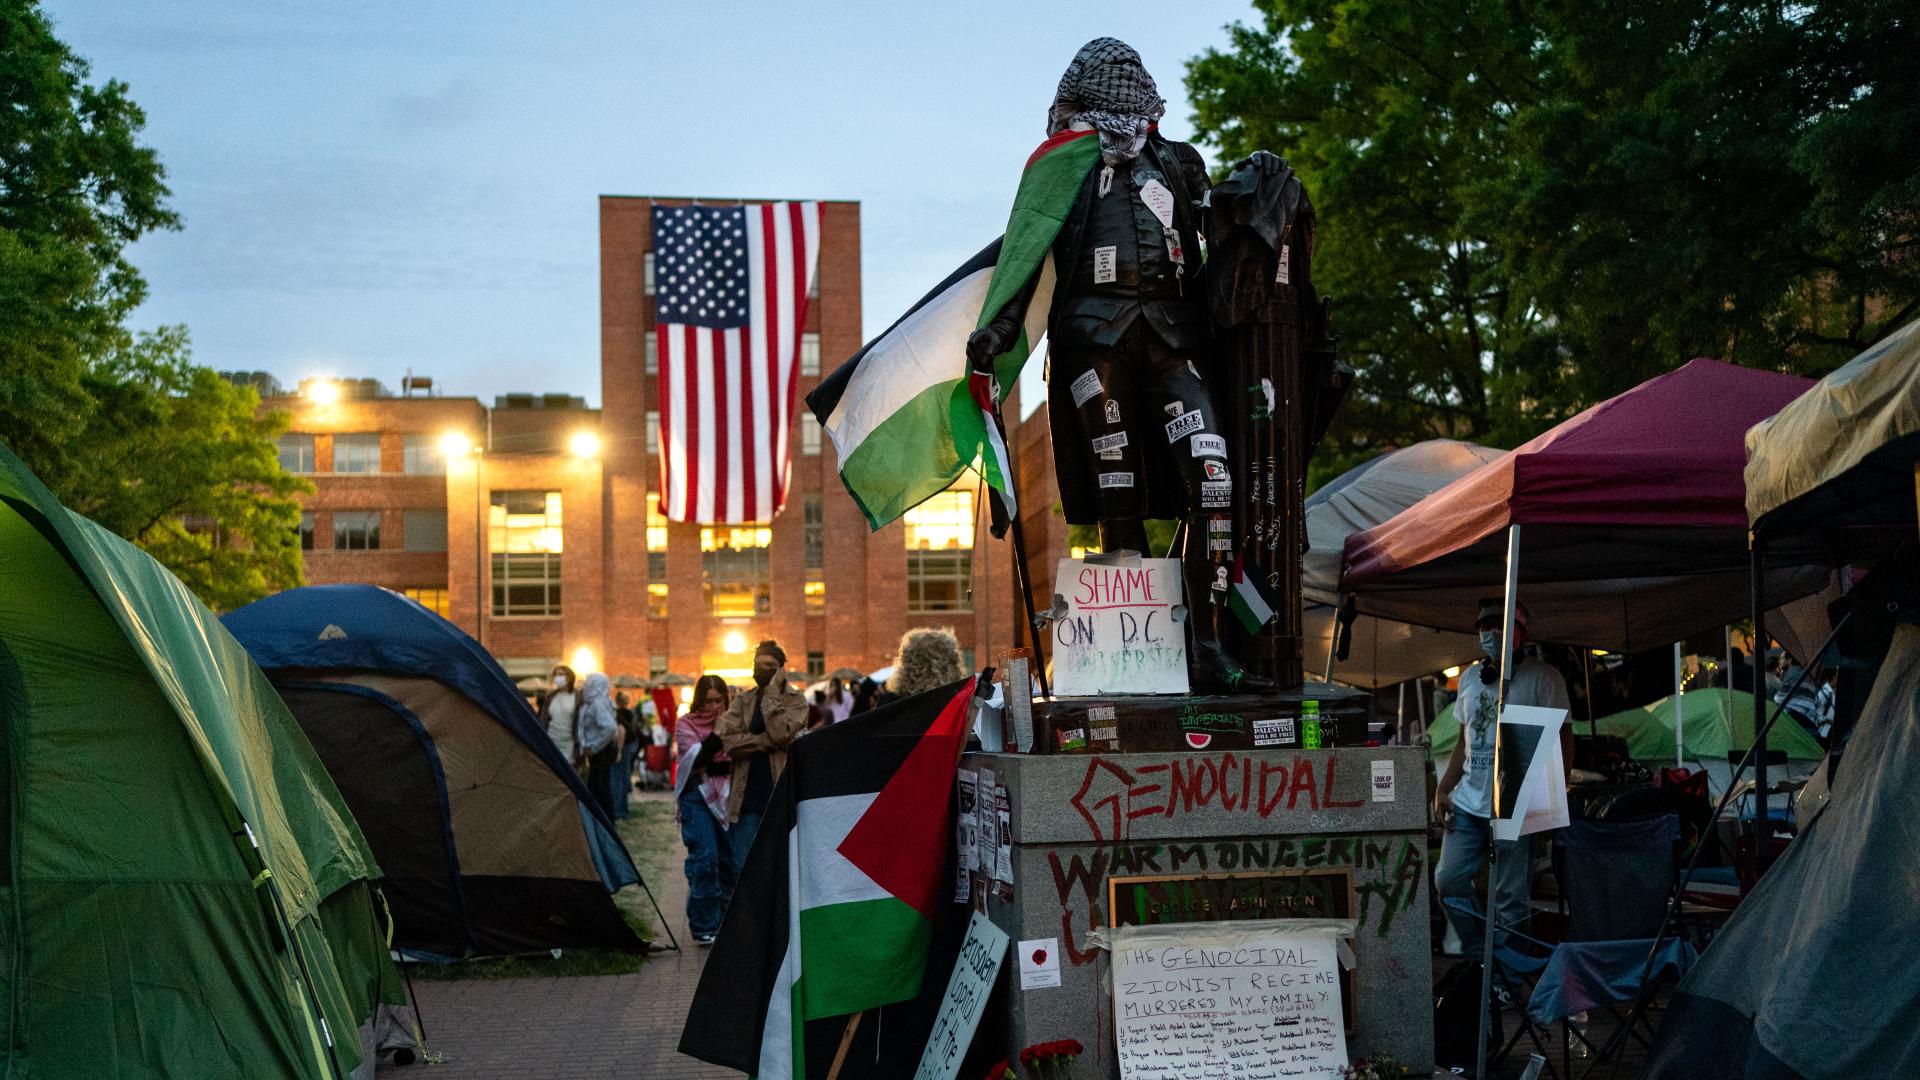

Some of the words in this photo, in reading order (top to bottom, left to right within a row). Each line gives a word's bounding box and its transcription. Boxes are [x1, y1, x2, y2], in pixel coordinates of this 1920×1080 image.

[1167, 412, 1201, 434] FREE
[1074, 568, 1160, 605] SHAME
[1057, 615, 1093, 647] ON
[1253, 725, 1294, 734] PALESTINE
[1070, 752, 1366, 843] GENOCIDAL
[1120, 948, 1155, 966] THE
[1161, 947, 1317, 968] GENOCIDAL
[950, 966, 983, 1026] Capital
[1122, 977, 1236, 995] ZIONIST
[1251, 971, 1334, 990] REGIME
[1124, 998, 1217, 1017] MURDERED
[1229, 995, 1253, 1009] MY
[1261, 990, 1329, 1006] FAMILY:
[942, 1020, 960, 1071] the
